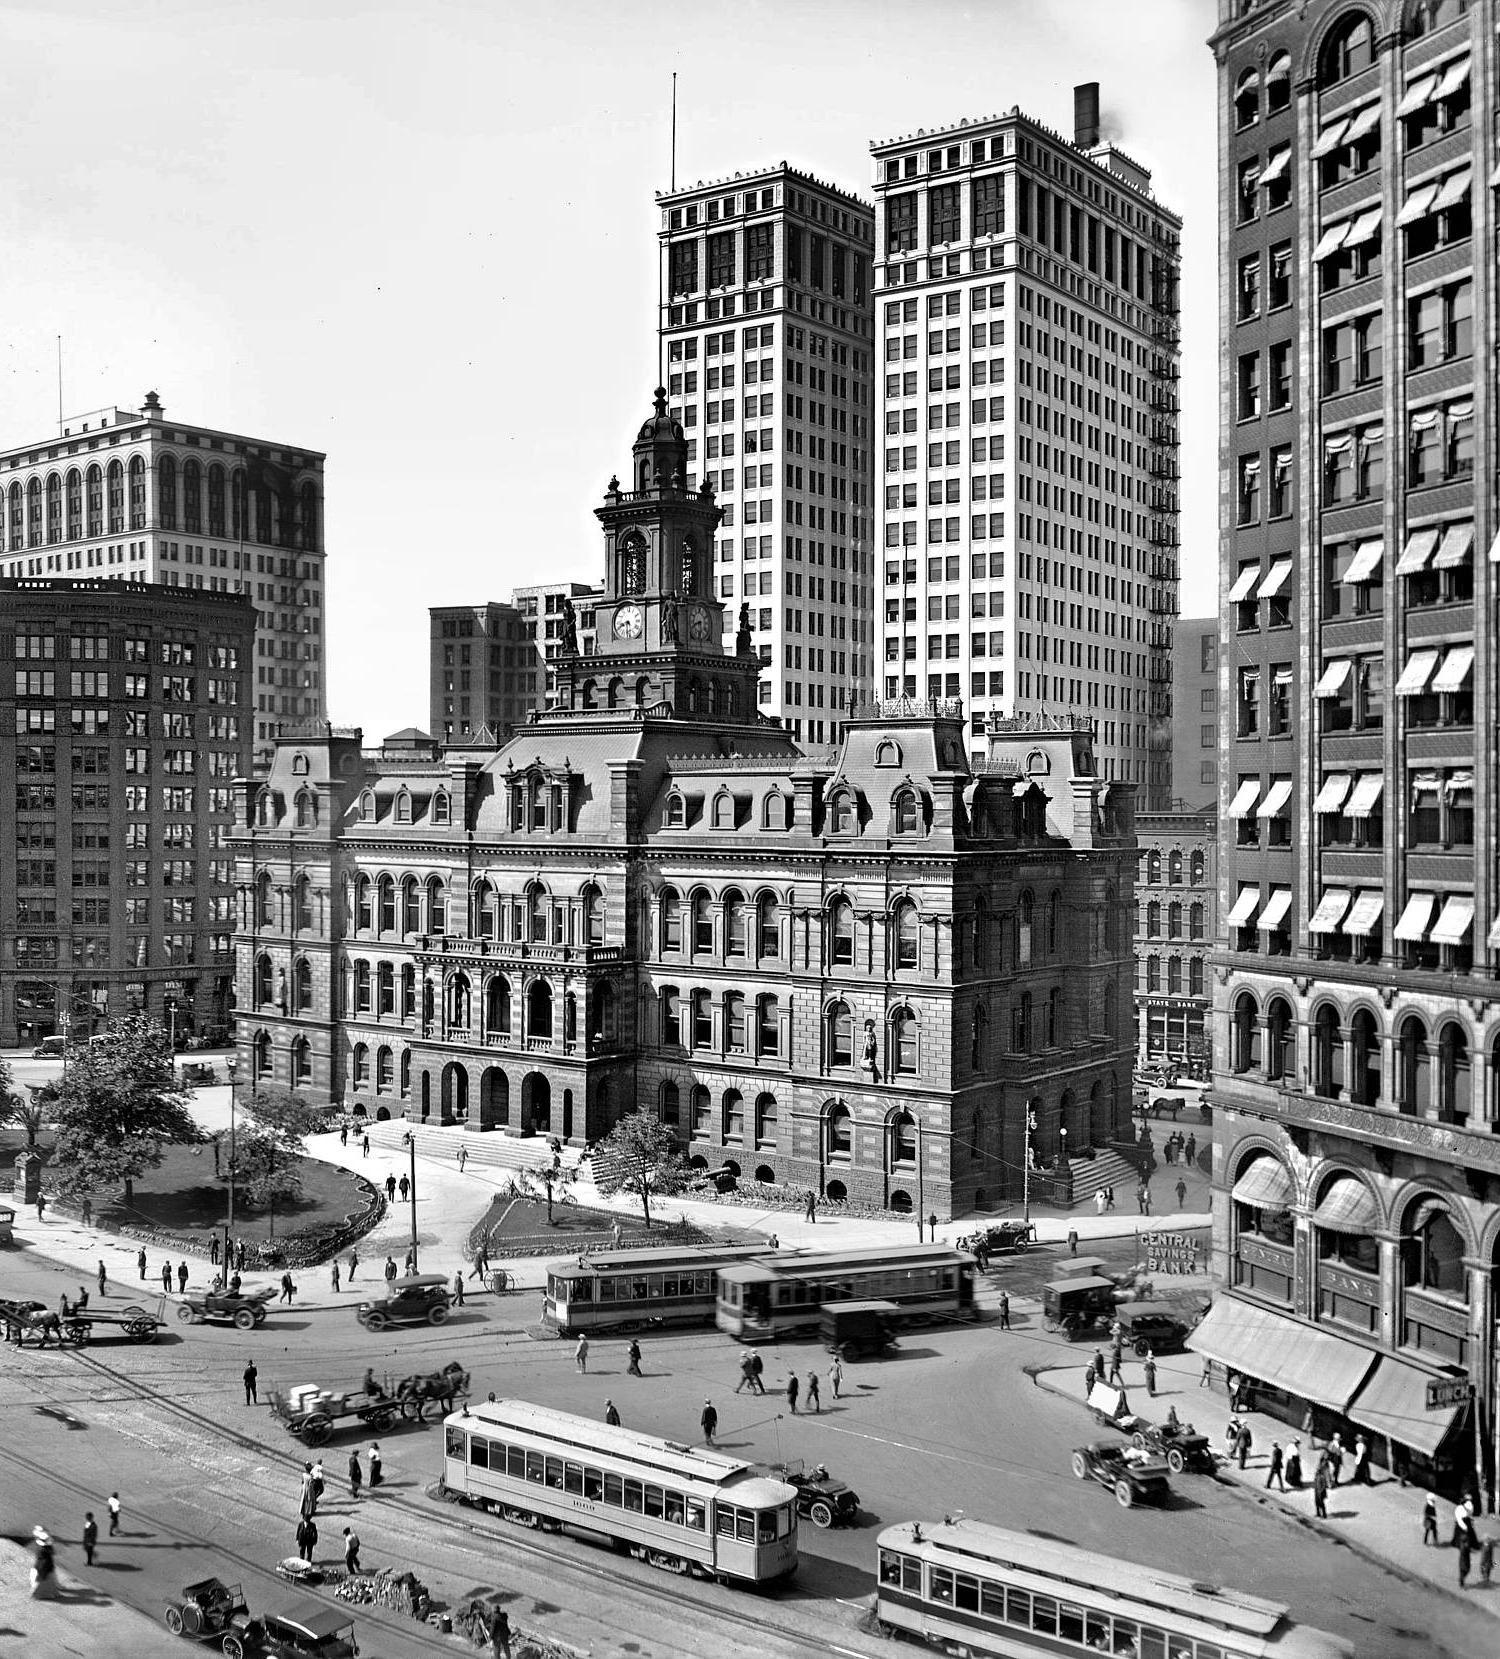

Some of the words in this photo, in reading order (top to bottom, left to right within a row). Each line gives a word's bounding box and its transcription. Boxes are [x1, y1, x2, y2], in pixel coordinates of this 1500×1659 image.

[1141, 1232, 1200, 1251] CENTRAL
[1147, 1247, 1195, 1261] SAVINGS
[1148, 1257, 1195, 1275] BANK
